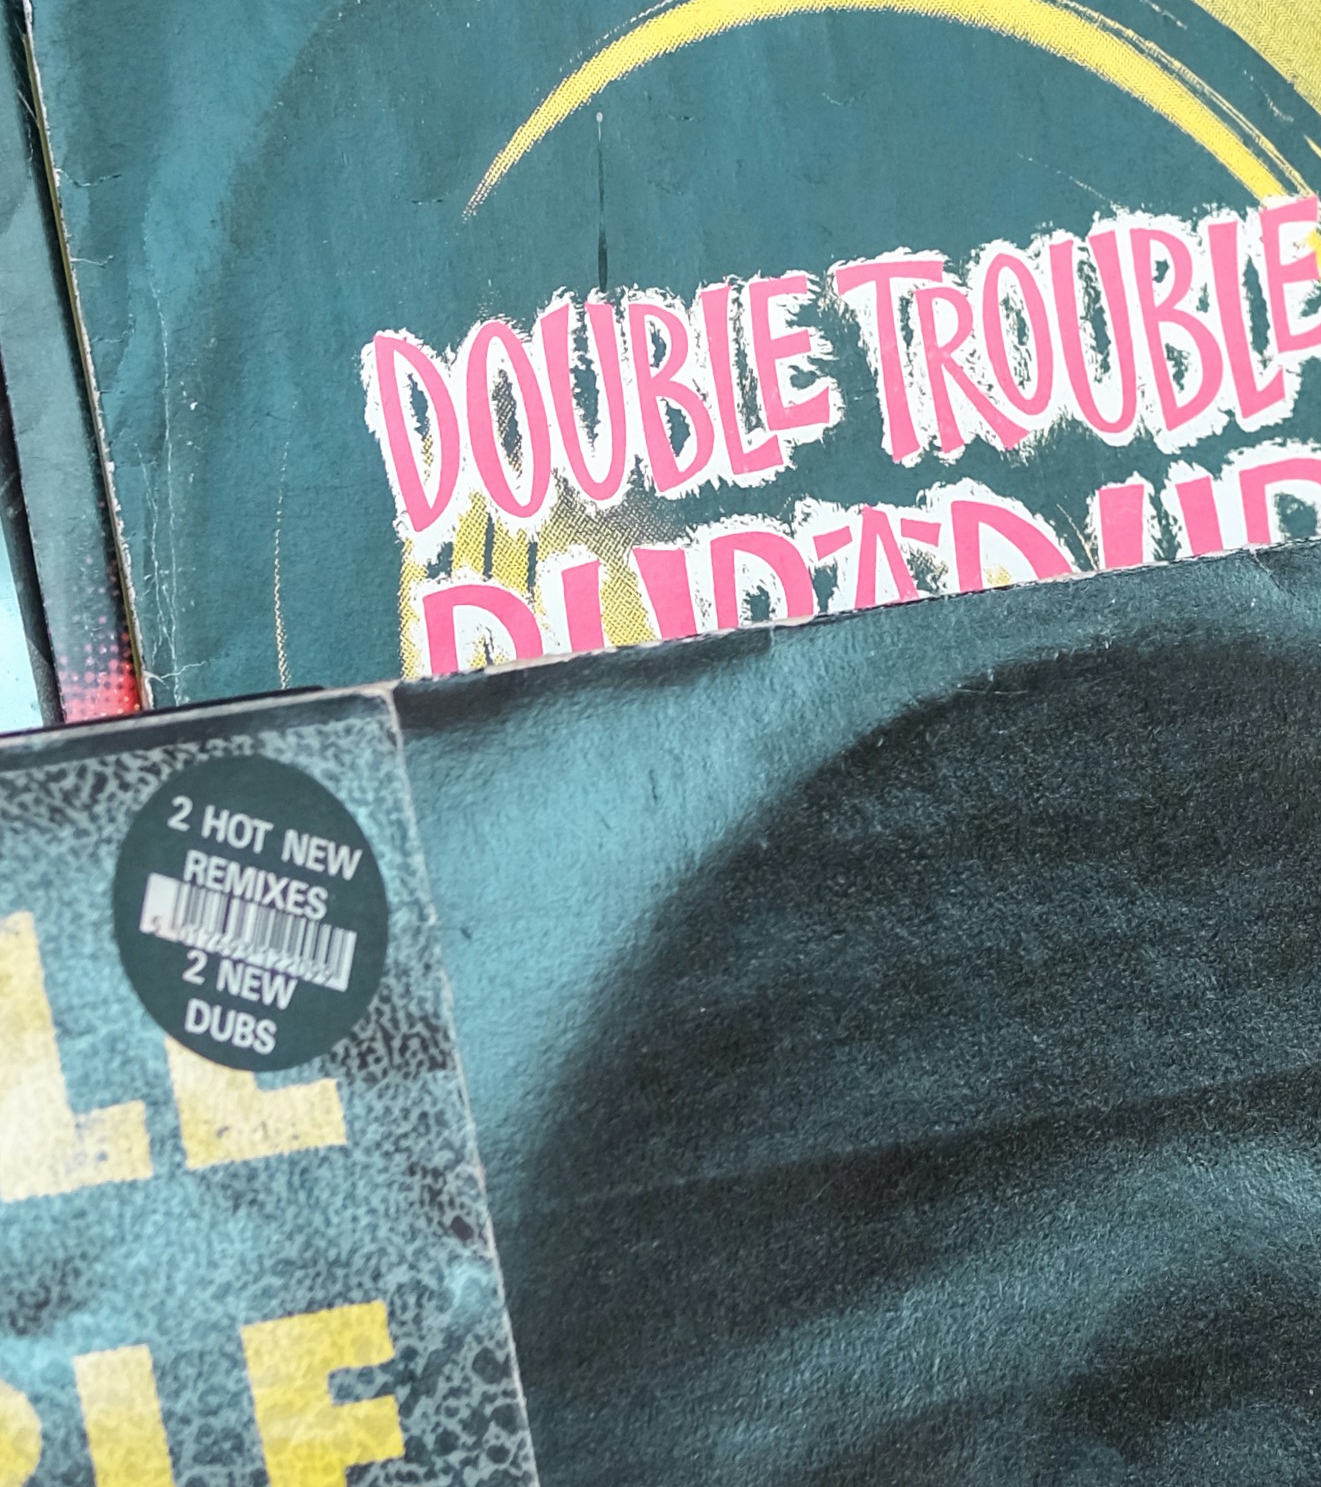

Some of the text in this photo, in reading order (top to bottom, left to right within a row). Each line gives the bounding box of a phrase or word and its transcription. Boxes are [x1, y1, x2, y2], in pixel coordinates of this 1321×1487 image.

[374, 272, 831, 533] DOUBLE
[167, 795, 362, 880] 2 HOT NEW
[183, 849, 329, 920] REMIXES
[182, 949, 208, 985] 2
[216, 958, 298, 1010] NEW
[184, 998, 277, 1055] DUBS
